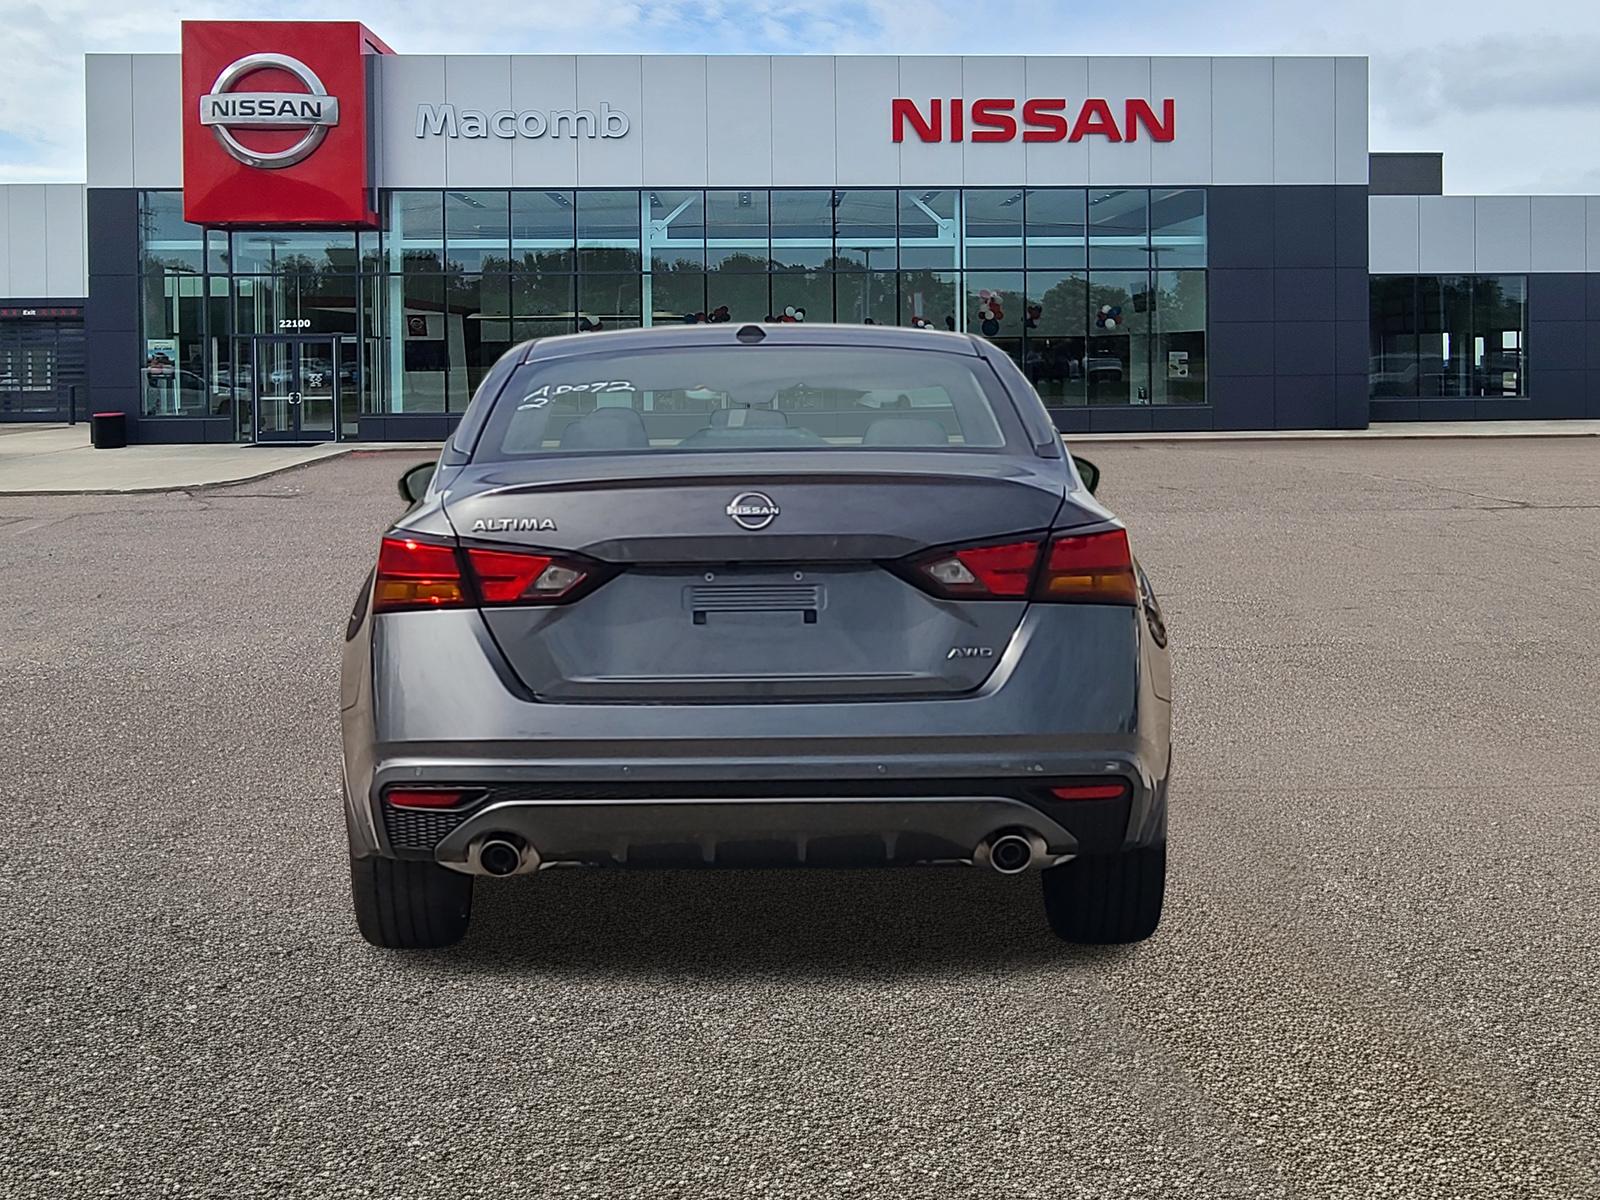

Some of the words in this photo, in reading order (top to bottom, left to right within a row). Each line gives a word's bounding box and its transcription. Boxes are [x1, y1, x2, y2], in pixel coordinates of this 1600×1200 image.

[212, 100, 322, 117] NISSAN
[415, 102, 630, 138] Macomb
[892, 99, 1175, 142] NISSAN
[279, 319, 311, 328] 22100
[726, 506, 780, 515] NISSAN
[472, 518, 557, 532] ALTIMA
[947, 647, 993, 659] AWD
